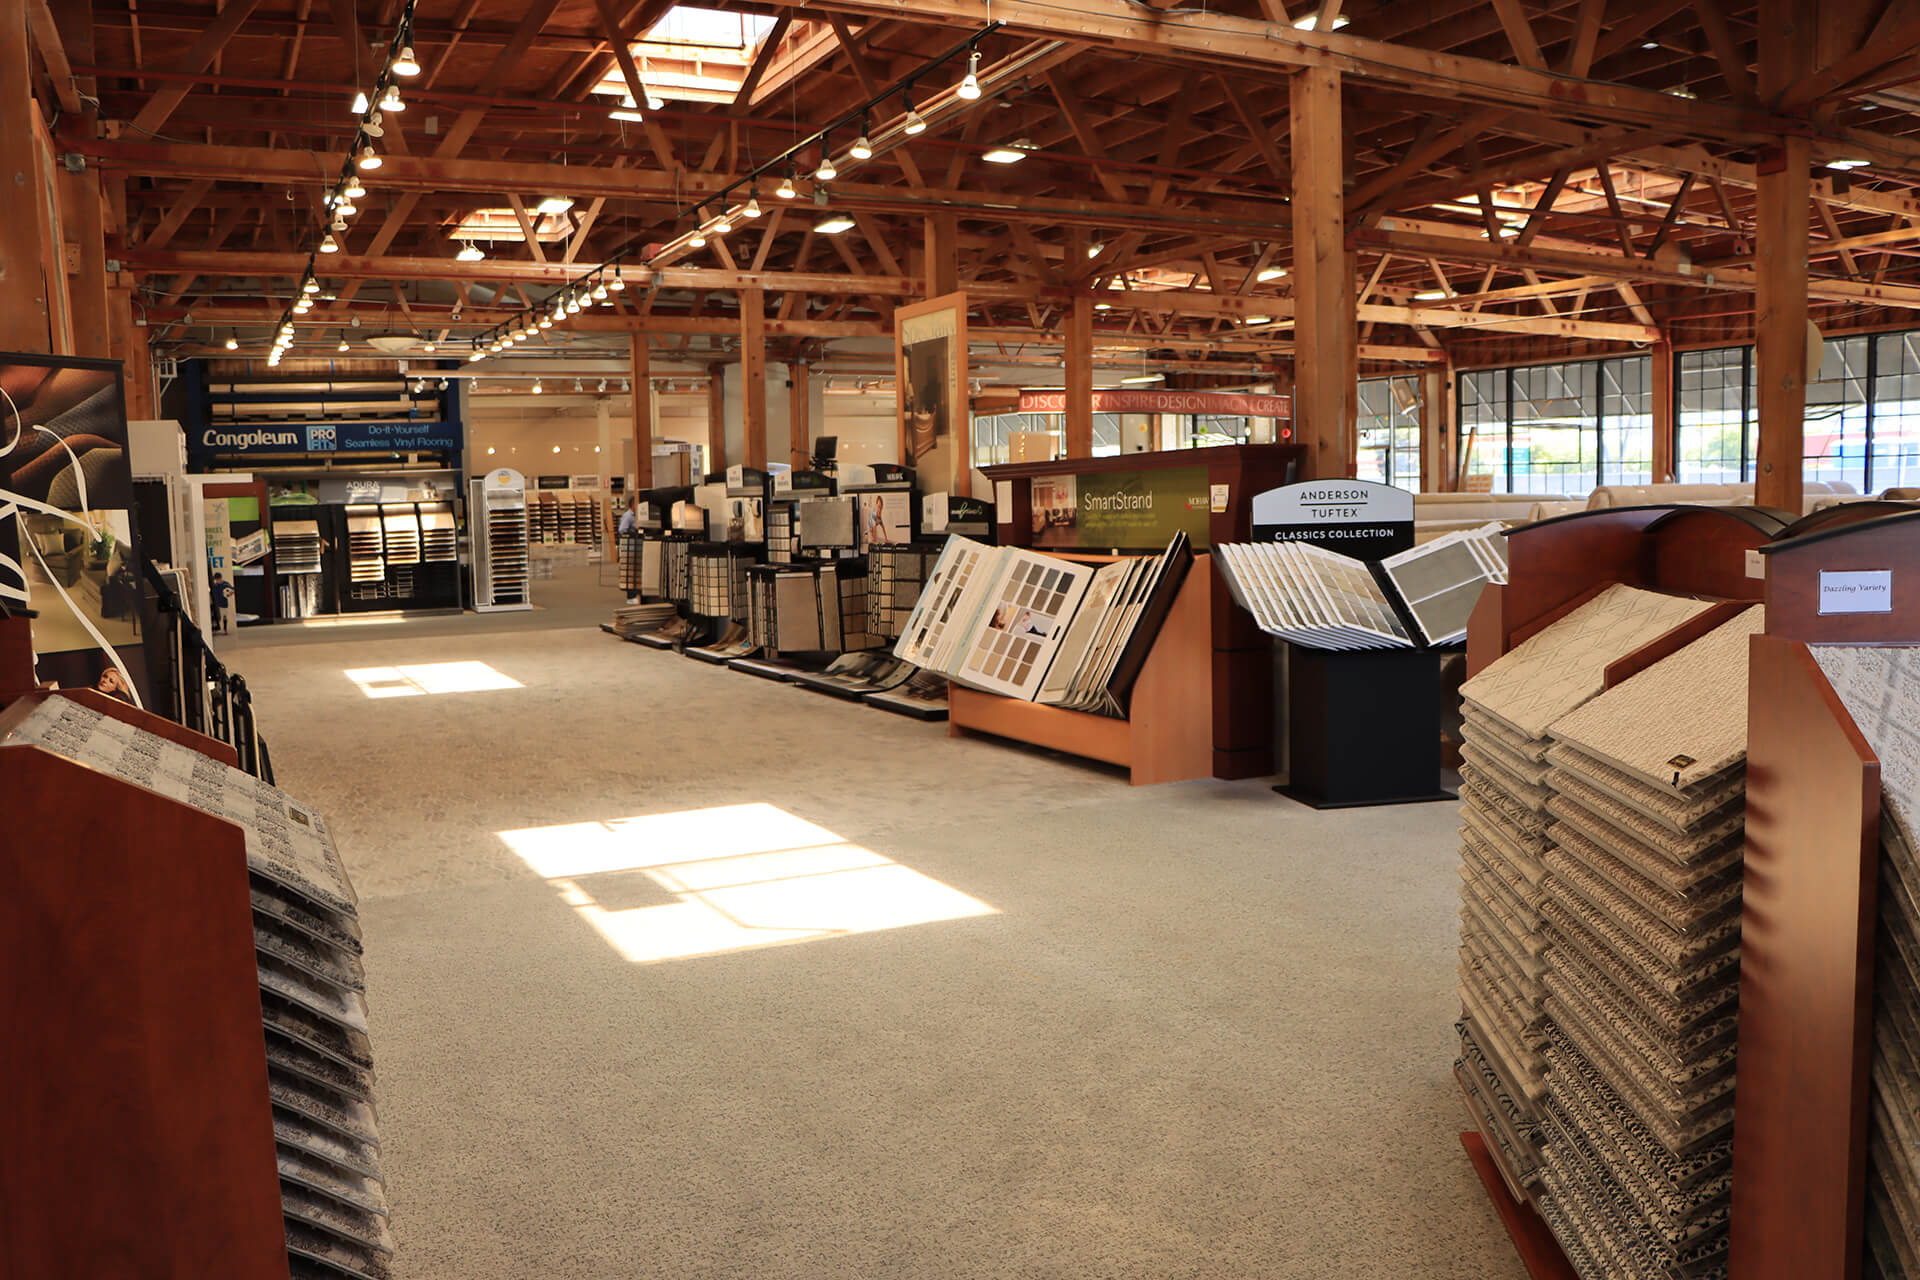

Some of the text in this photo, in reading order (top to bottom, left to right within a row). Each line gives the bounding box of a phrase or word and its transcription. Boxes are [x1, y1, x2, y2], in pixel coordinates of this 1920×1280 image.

[1105, 393, 1156, 409] INSPIRE
[1157, 394, 1207, 410] DESIGN
[1256, 398, 1289, 414] CREATE
[202, 429, 299, 450] Congoleum
[311, 429, 336, 440] PRO
[344, 436, 454, 449] Seamless Vinyl Flooring
[346, 481, 380, 489] ADURA
[1300, 489, 1369, 500] ANDERSON
[1084, 490, 1153, 511] SmartStrand
[1311, 508, 1359, 518] TUFTEX
[1274, 529, 1395, 541] CLASSICS COLLECTION
[1823, 583, 1888, 593] Dazzling Variety
